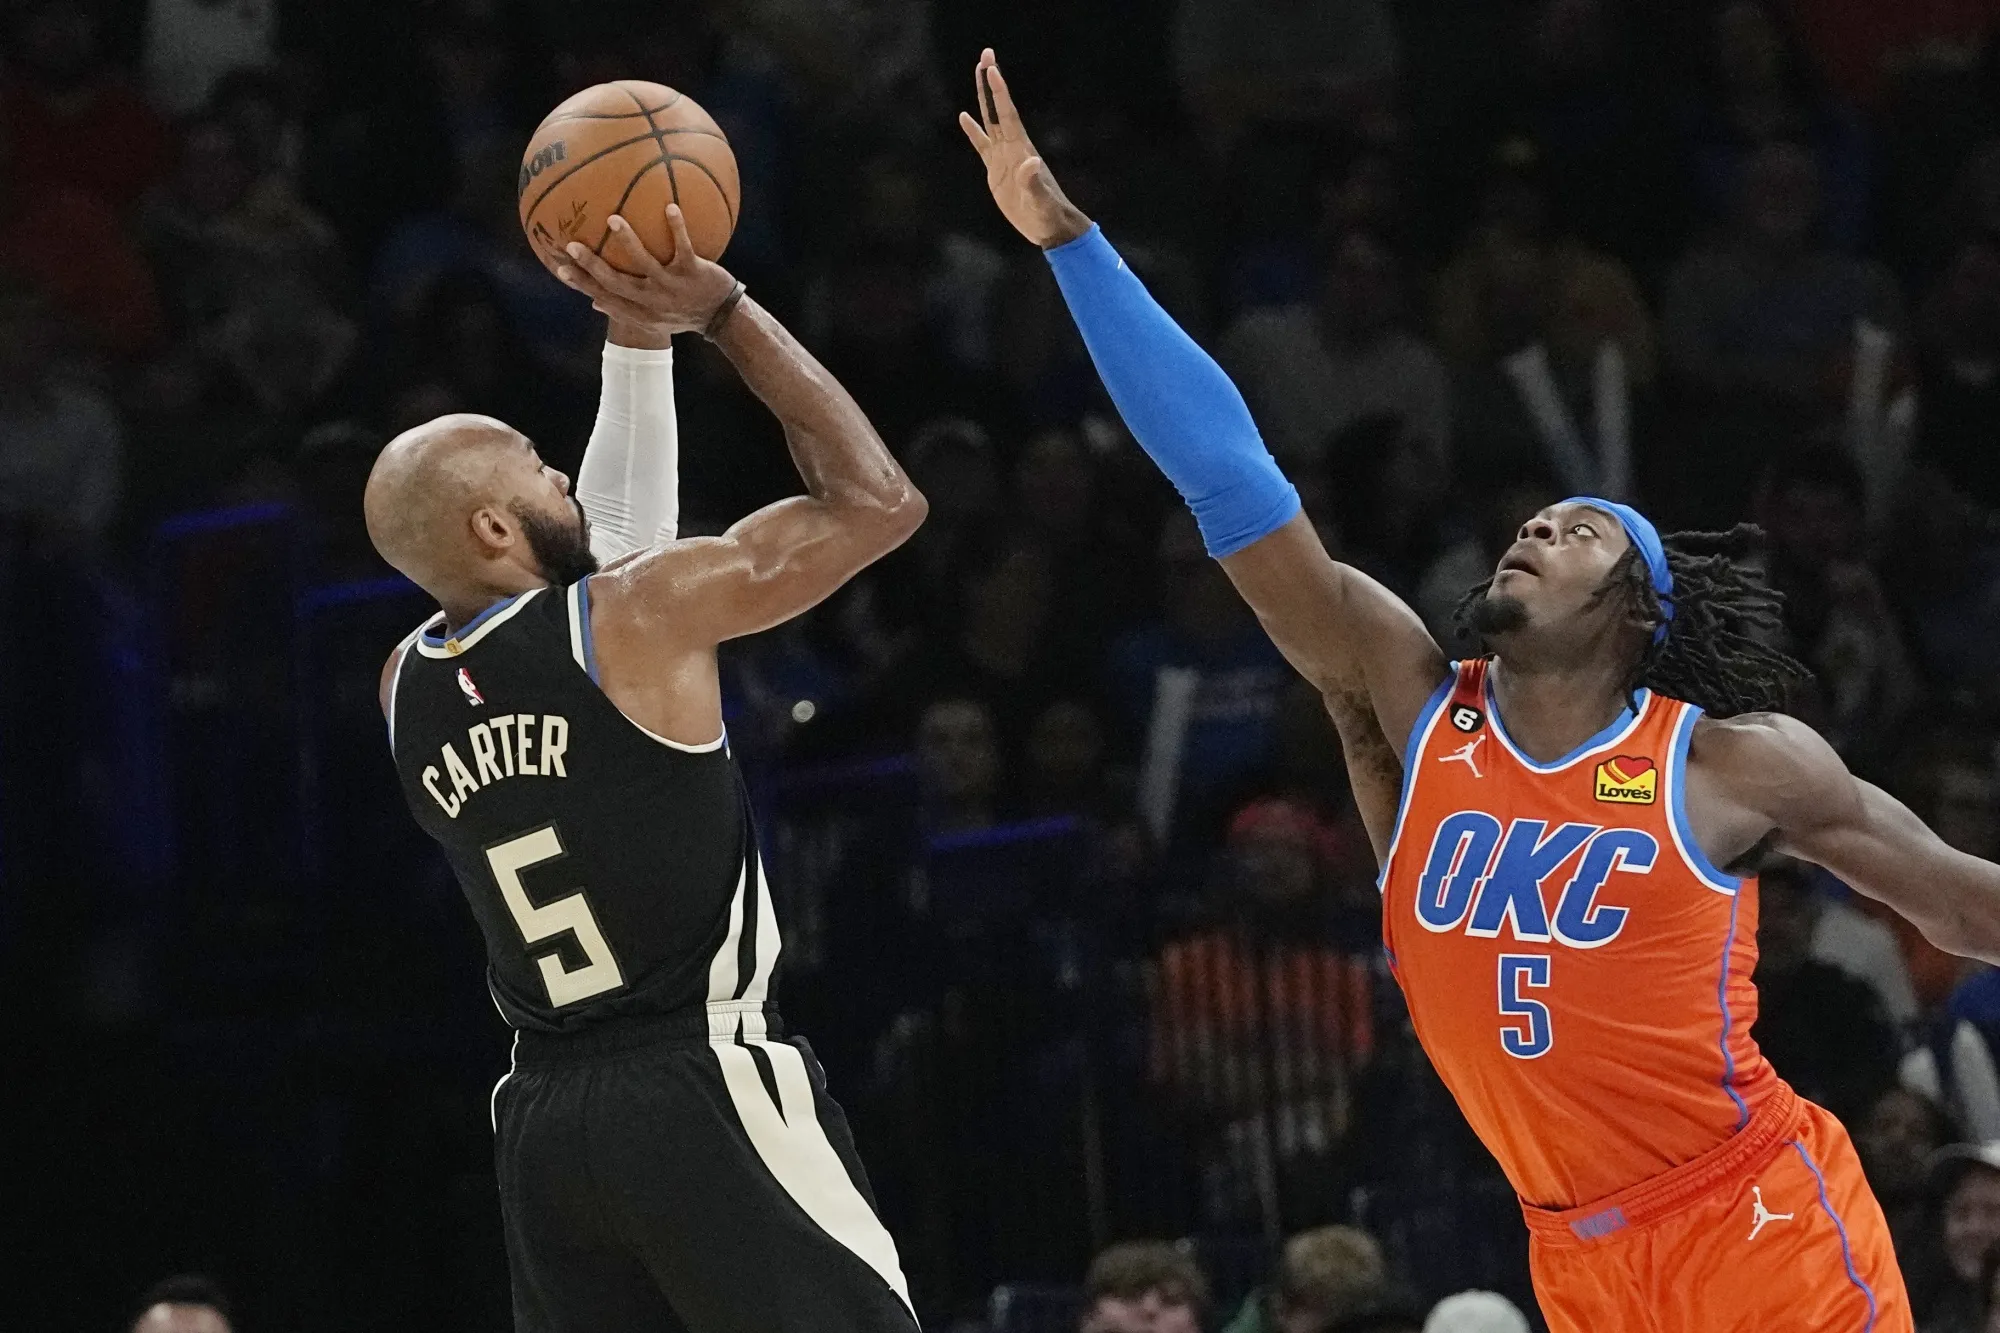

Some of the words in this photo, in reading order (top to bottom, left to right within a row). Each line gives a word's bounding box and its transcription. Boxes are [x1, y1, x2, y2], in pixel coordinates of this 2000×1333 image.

[422, 713, 569, 819] CARTER
[1453, 706, 1479, 731] 6
[485, 824, 625, 1009] 5
[1414, 810, 1660, 949] OKC
[1498, 954, 1553, 1060] 5
